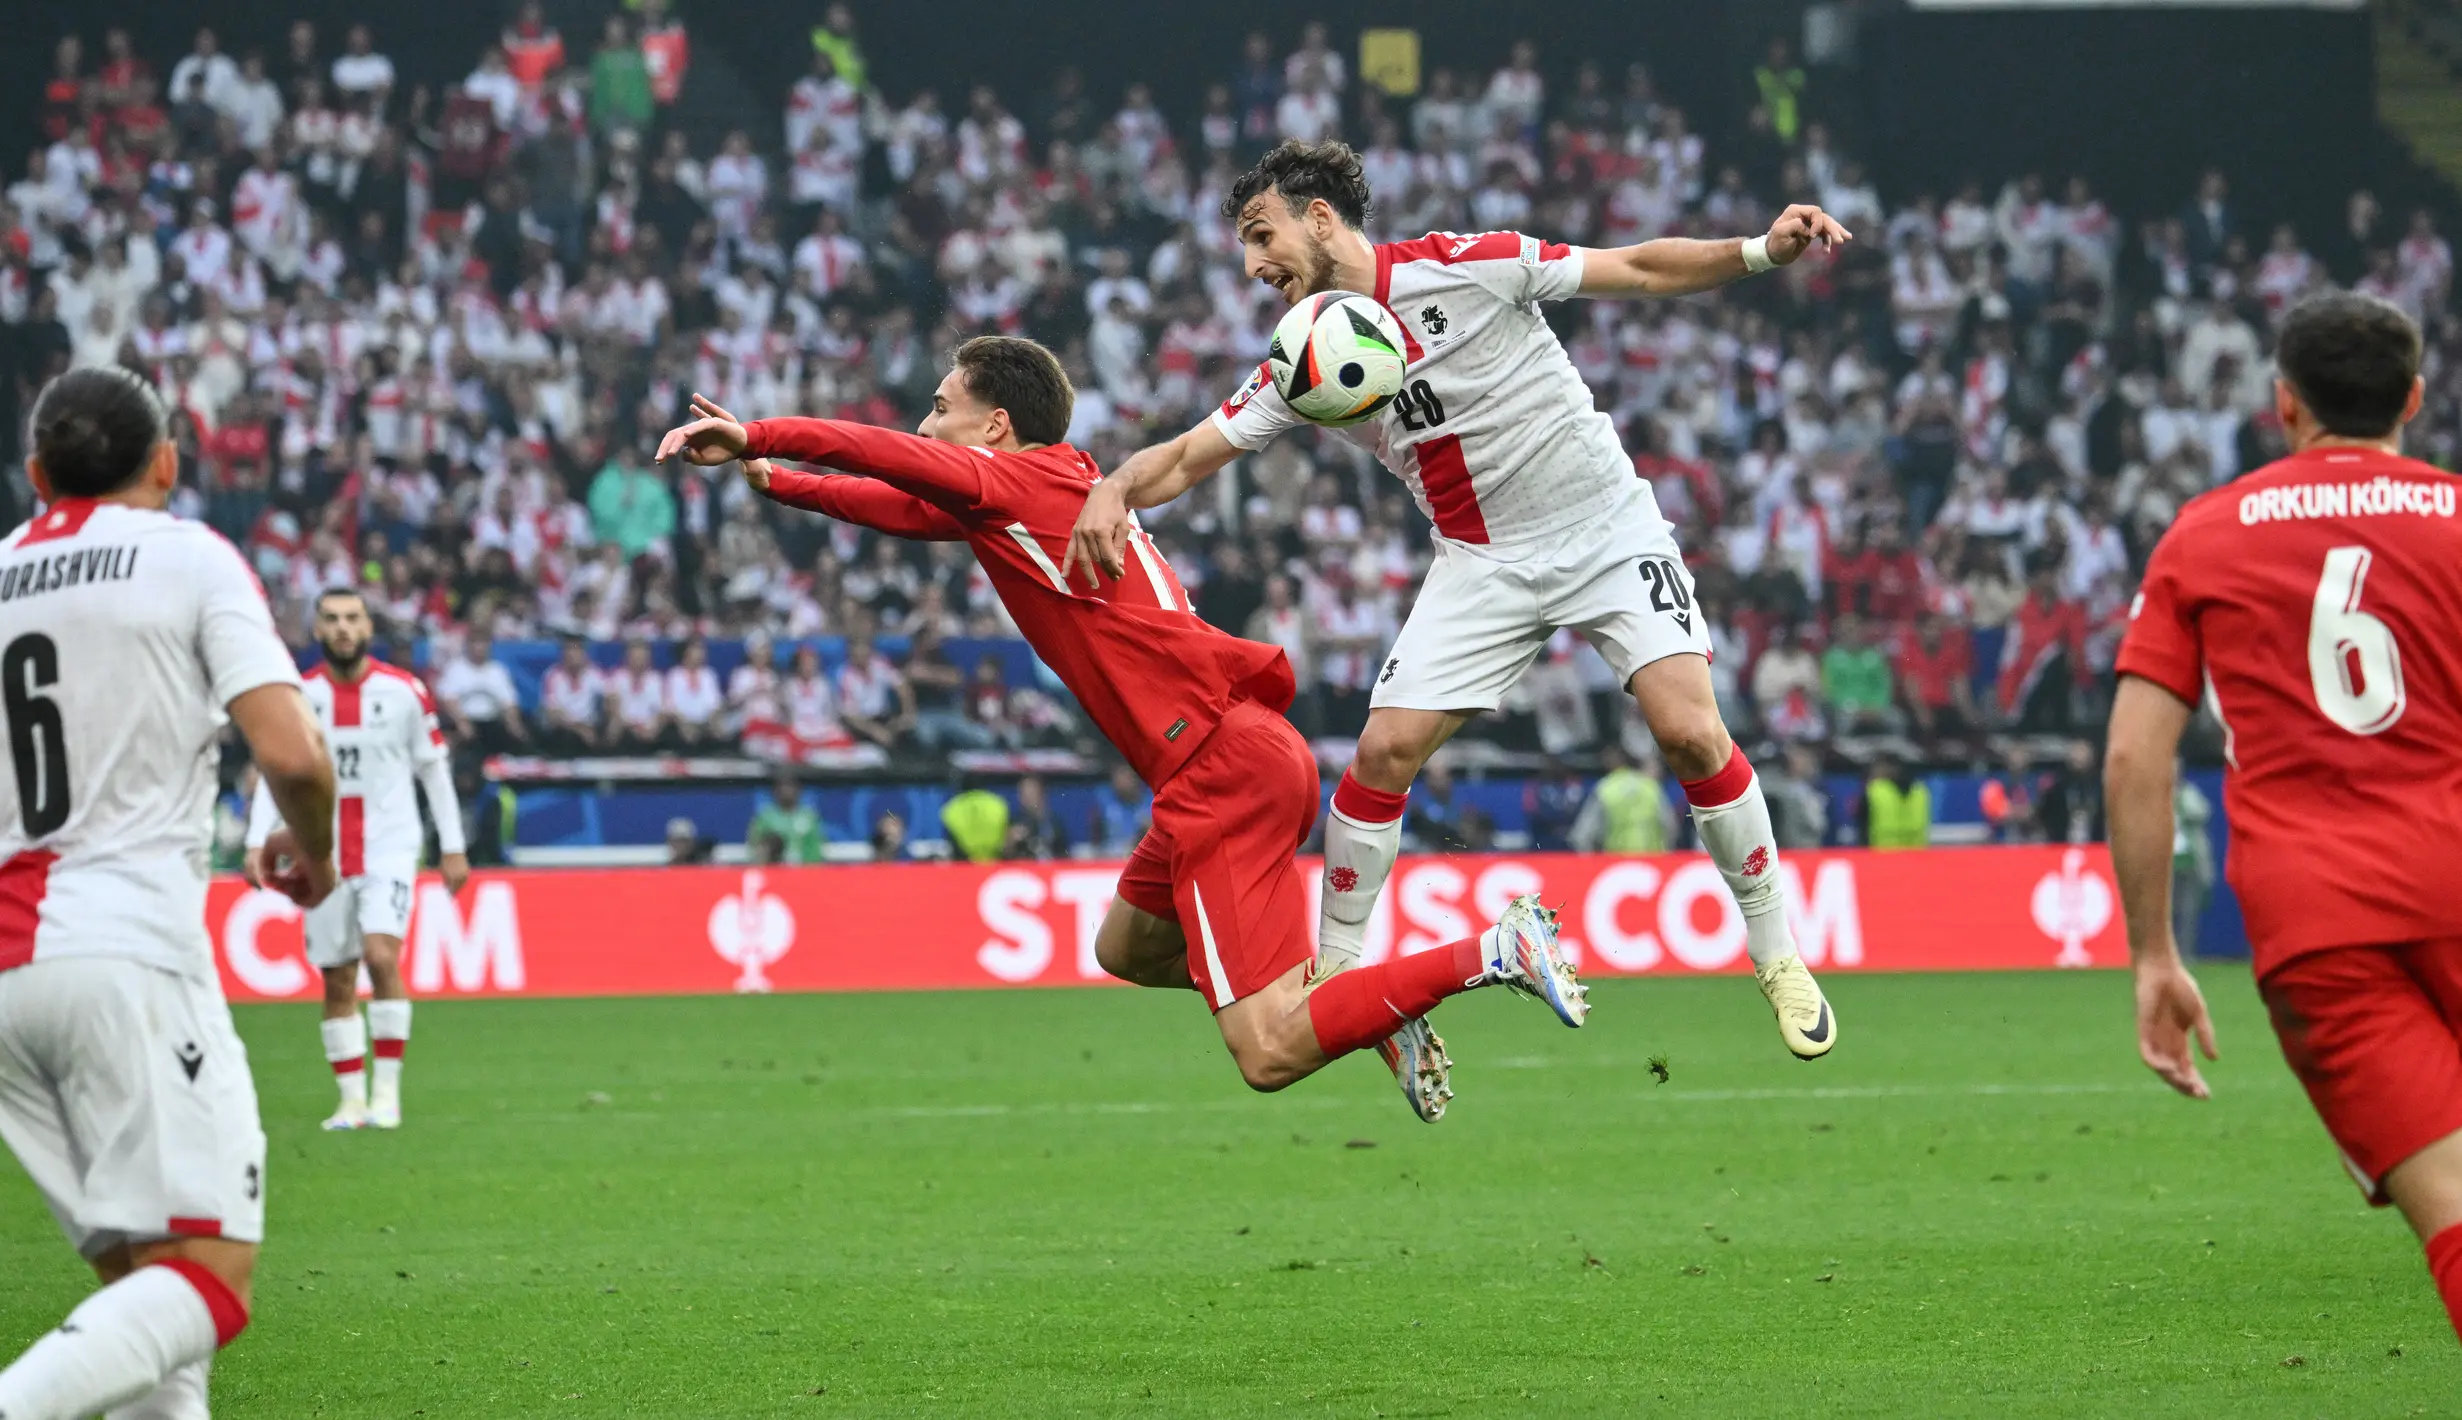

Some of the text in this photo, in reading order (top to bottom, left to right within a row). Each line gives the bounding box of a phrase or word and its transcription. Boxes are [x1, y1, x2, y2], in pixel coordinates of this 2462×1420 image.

[1393, 379, 1446, 431] 20
[2239, 484, 2348, 526] ORKUN
[0, 546, 138, 603] ORASHVILI
[1638, 560, 1691, 613] 20
[2307, 545, 2407, 736] 6
[2, 631, 72, 841] 6
[337, 746, 361, 780] 22
[224, 881, 527, 995] CM
